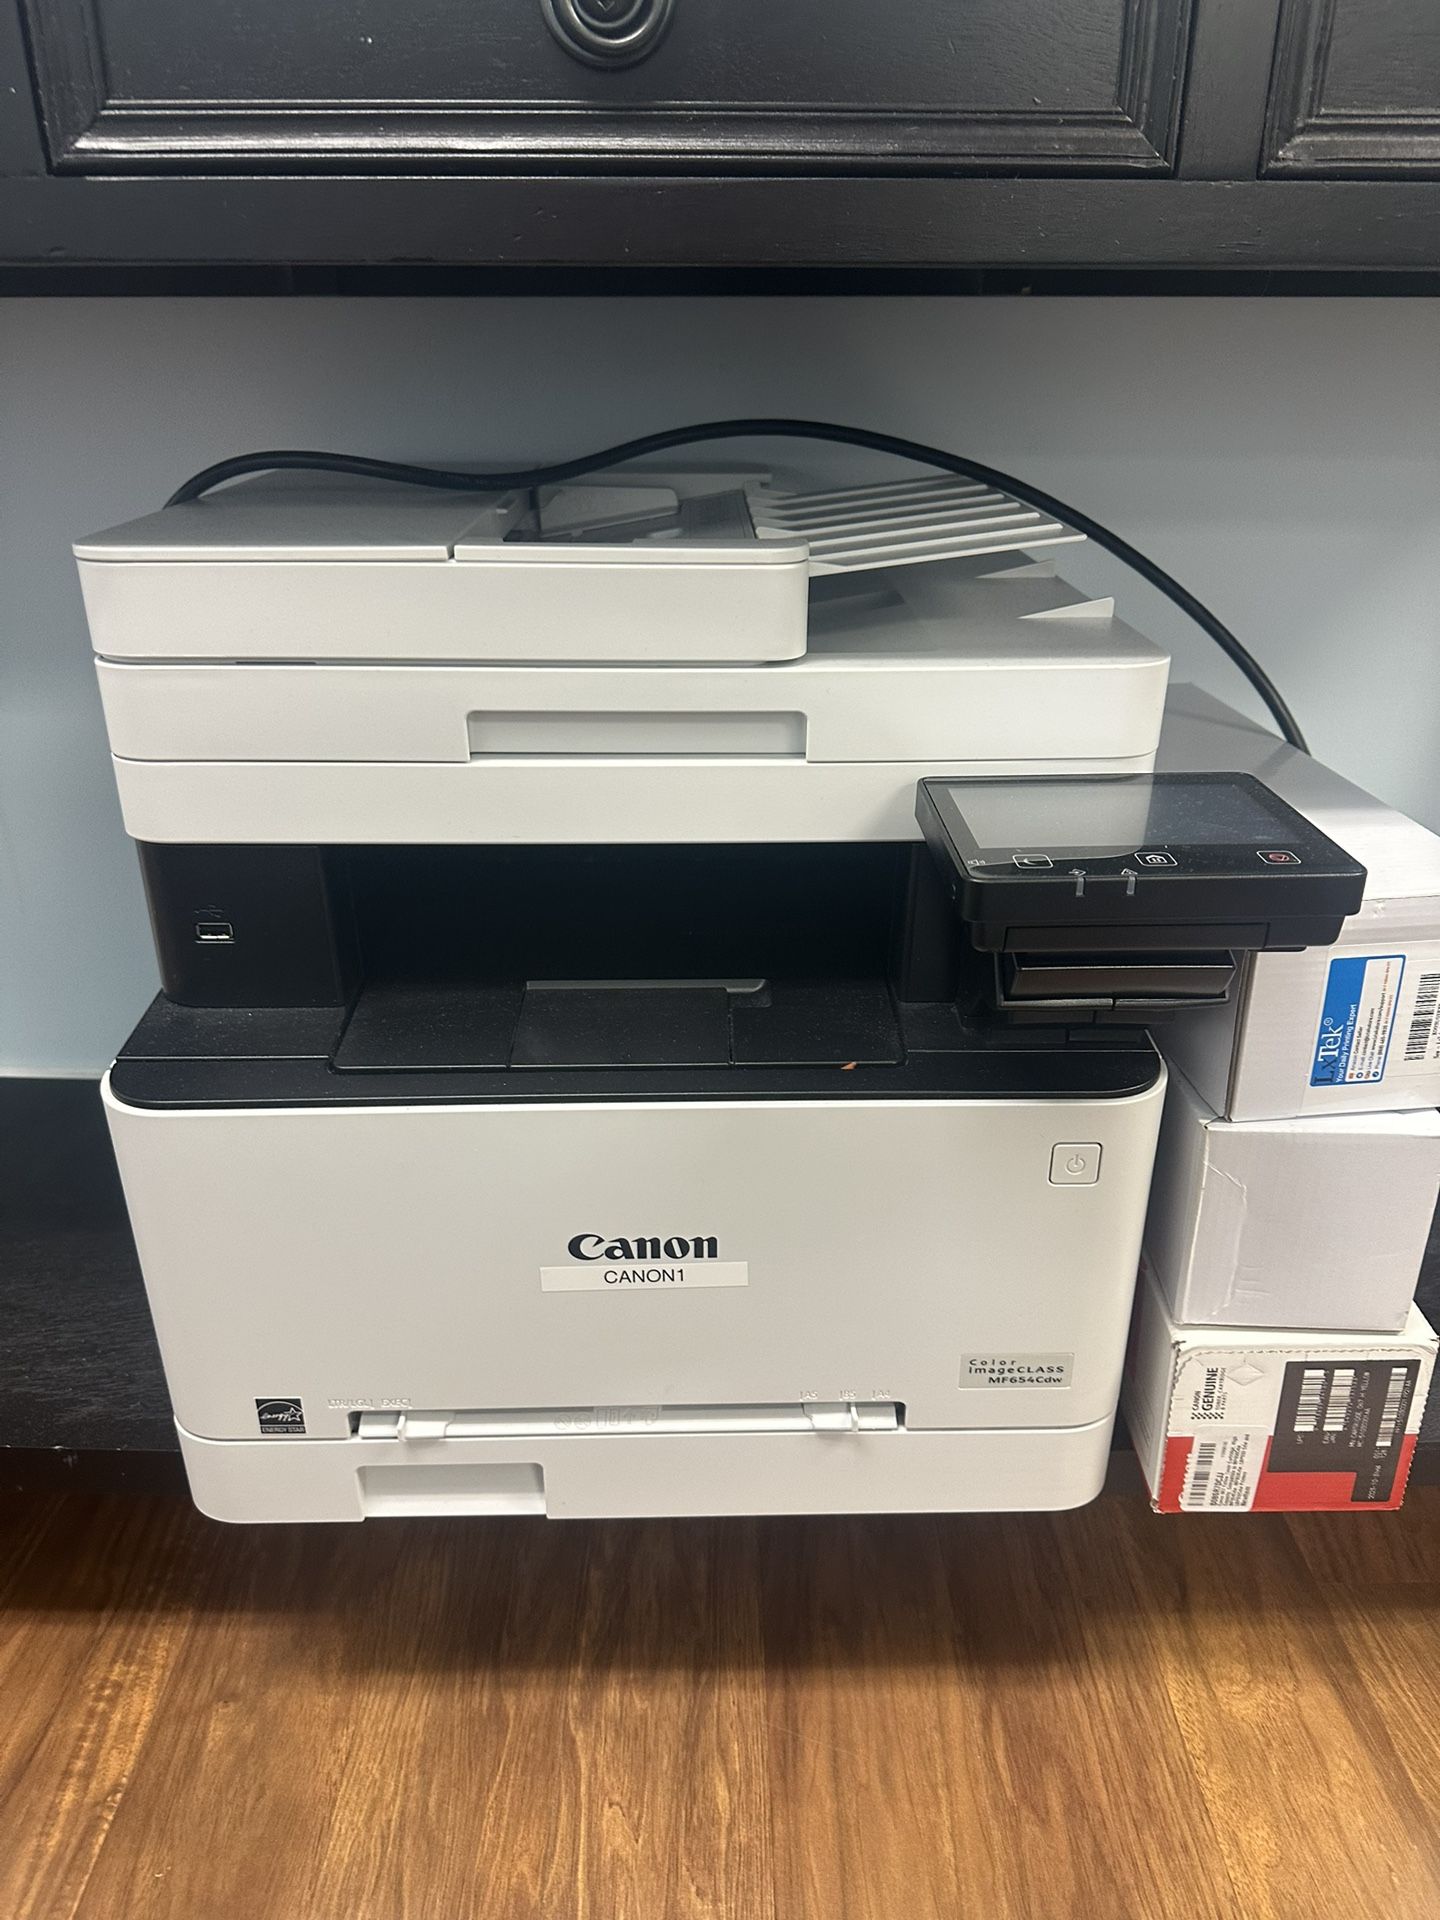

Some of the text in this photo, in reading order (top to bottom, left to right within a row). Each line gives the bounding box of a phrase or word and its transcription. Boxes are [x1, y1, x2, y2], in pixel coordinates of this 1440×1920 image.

[1335, 1004, 1357, 1083] Your Daily Printing Expert
[567, 1233, 717, 1260] Canon
[603, 1269, 685, 1283] CANON1
[969, 1366, 1064, 1375] imageCLASS
[988, 1376, 1062, 1384] MF654Cdw
[1201, 1367, 1219, 1411] GENUINE
[1192, 1391, 1201, 1411] CANON
